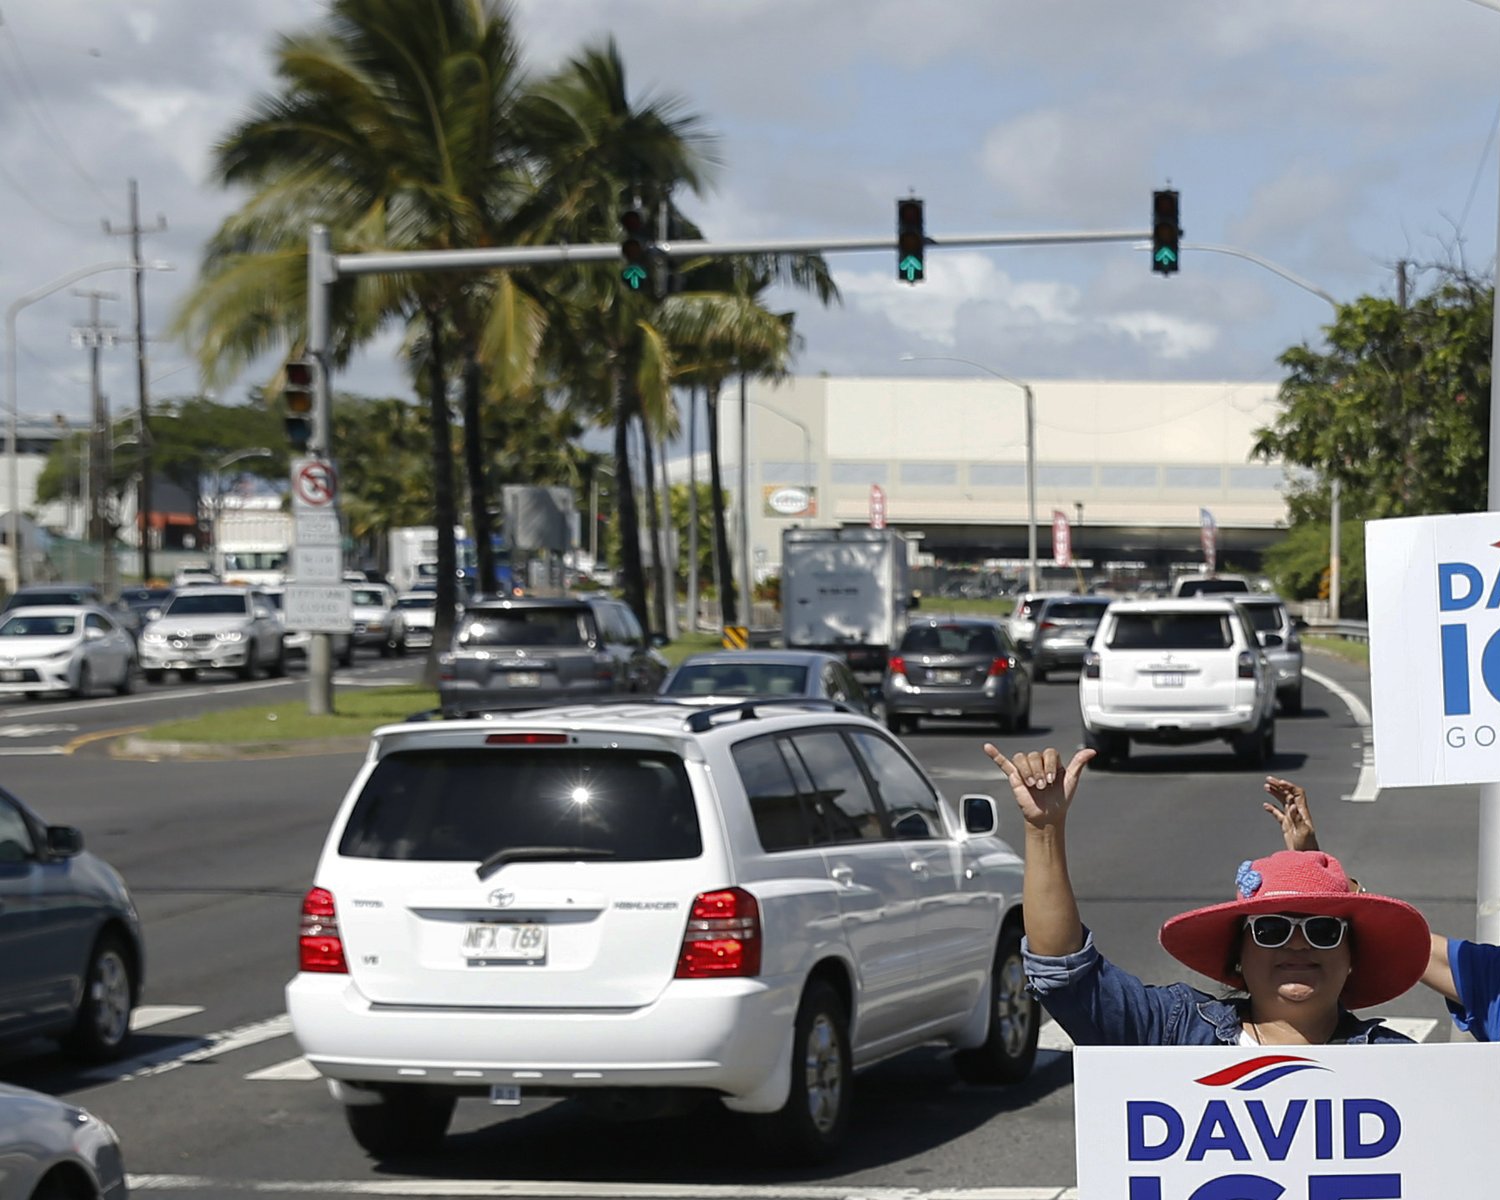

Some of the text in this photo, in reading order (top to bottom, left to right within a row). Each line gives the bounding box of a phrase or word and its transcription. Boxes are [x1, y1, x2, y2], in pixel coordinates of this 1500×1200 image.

[463, 927, 542, 948] NFX 769
[1126, 1098, 1402, 1162] DAVID
